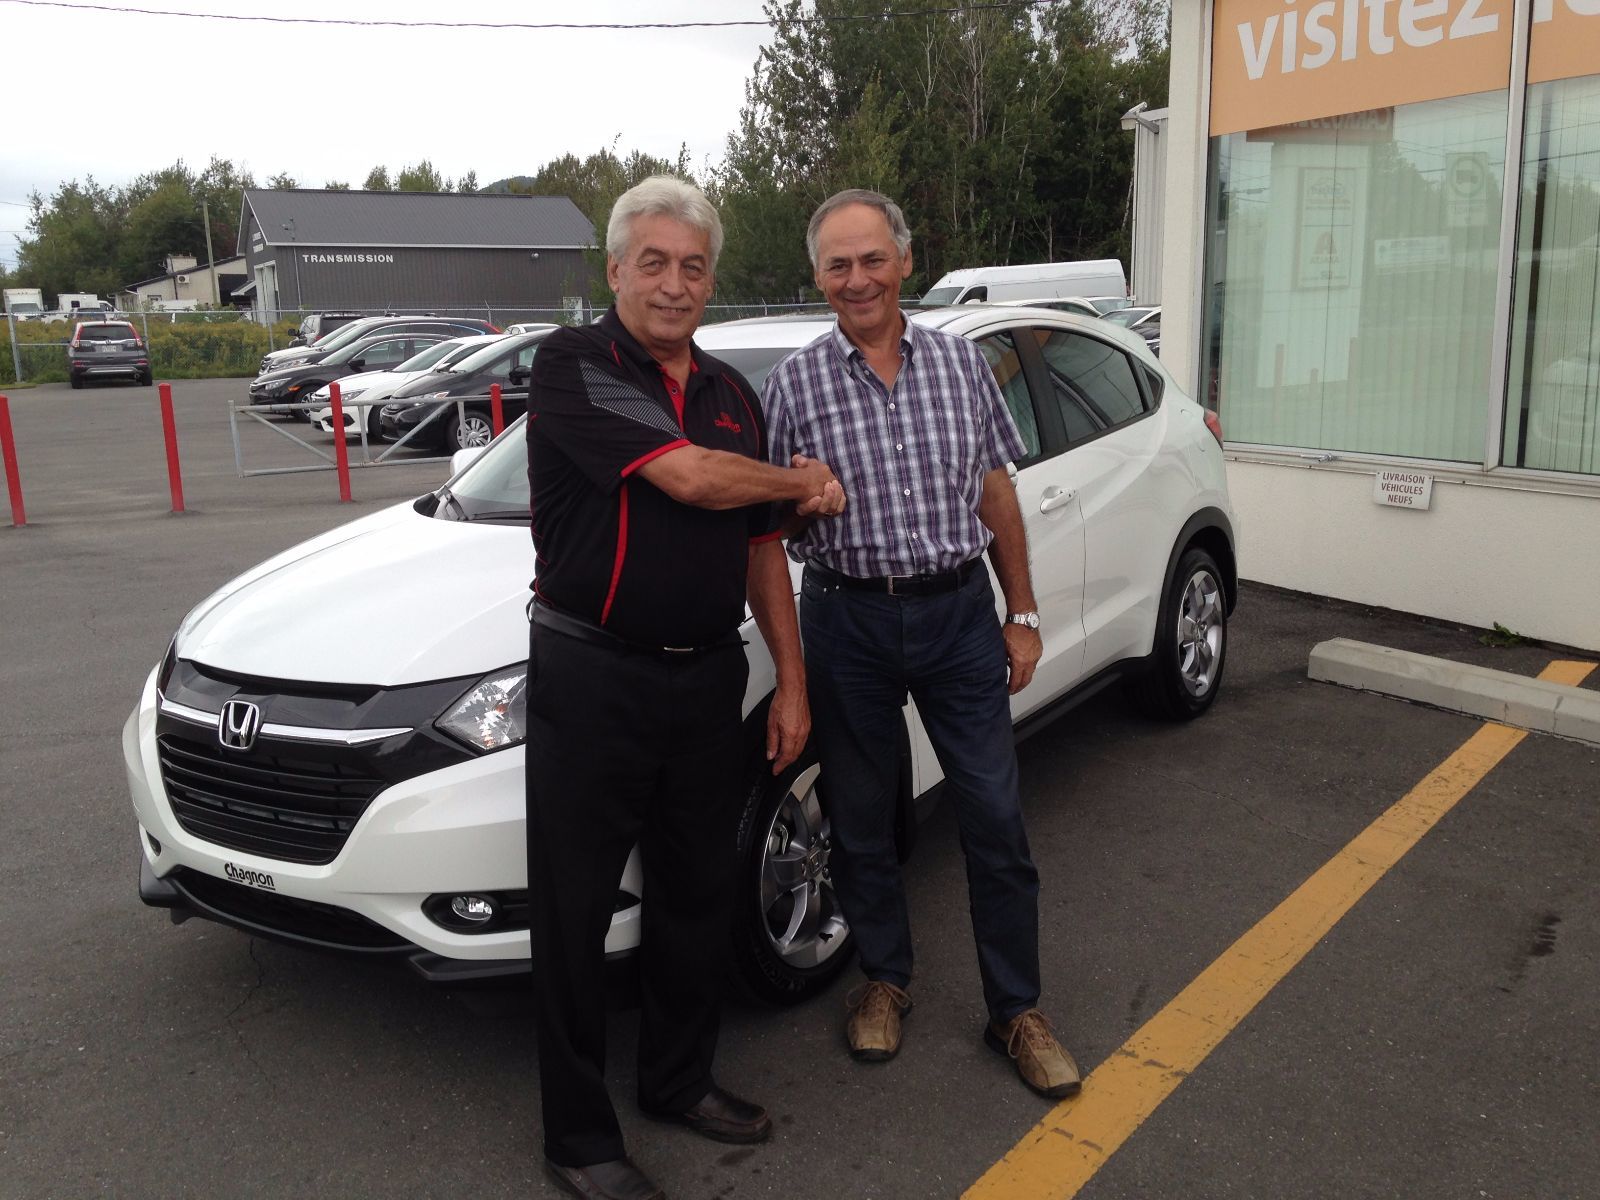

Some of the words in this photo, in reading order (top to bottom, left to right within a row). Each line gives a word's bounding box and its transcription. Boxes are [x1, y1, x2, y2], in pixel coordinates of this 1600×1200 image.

[1237, 0, 1499, 81] visitez
[302, 254, 393, 263] TRANSMISSION
[1382, 472, 1426, 484] LIVRAISON
[1387, 494, 1413, 505] NEUFS
[224, 862, 275, 887] Chagnon
